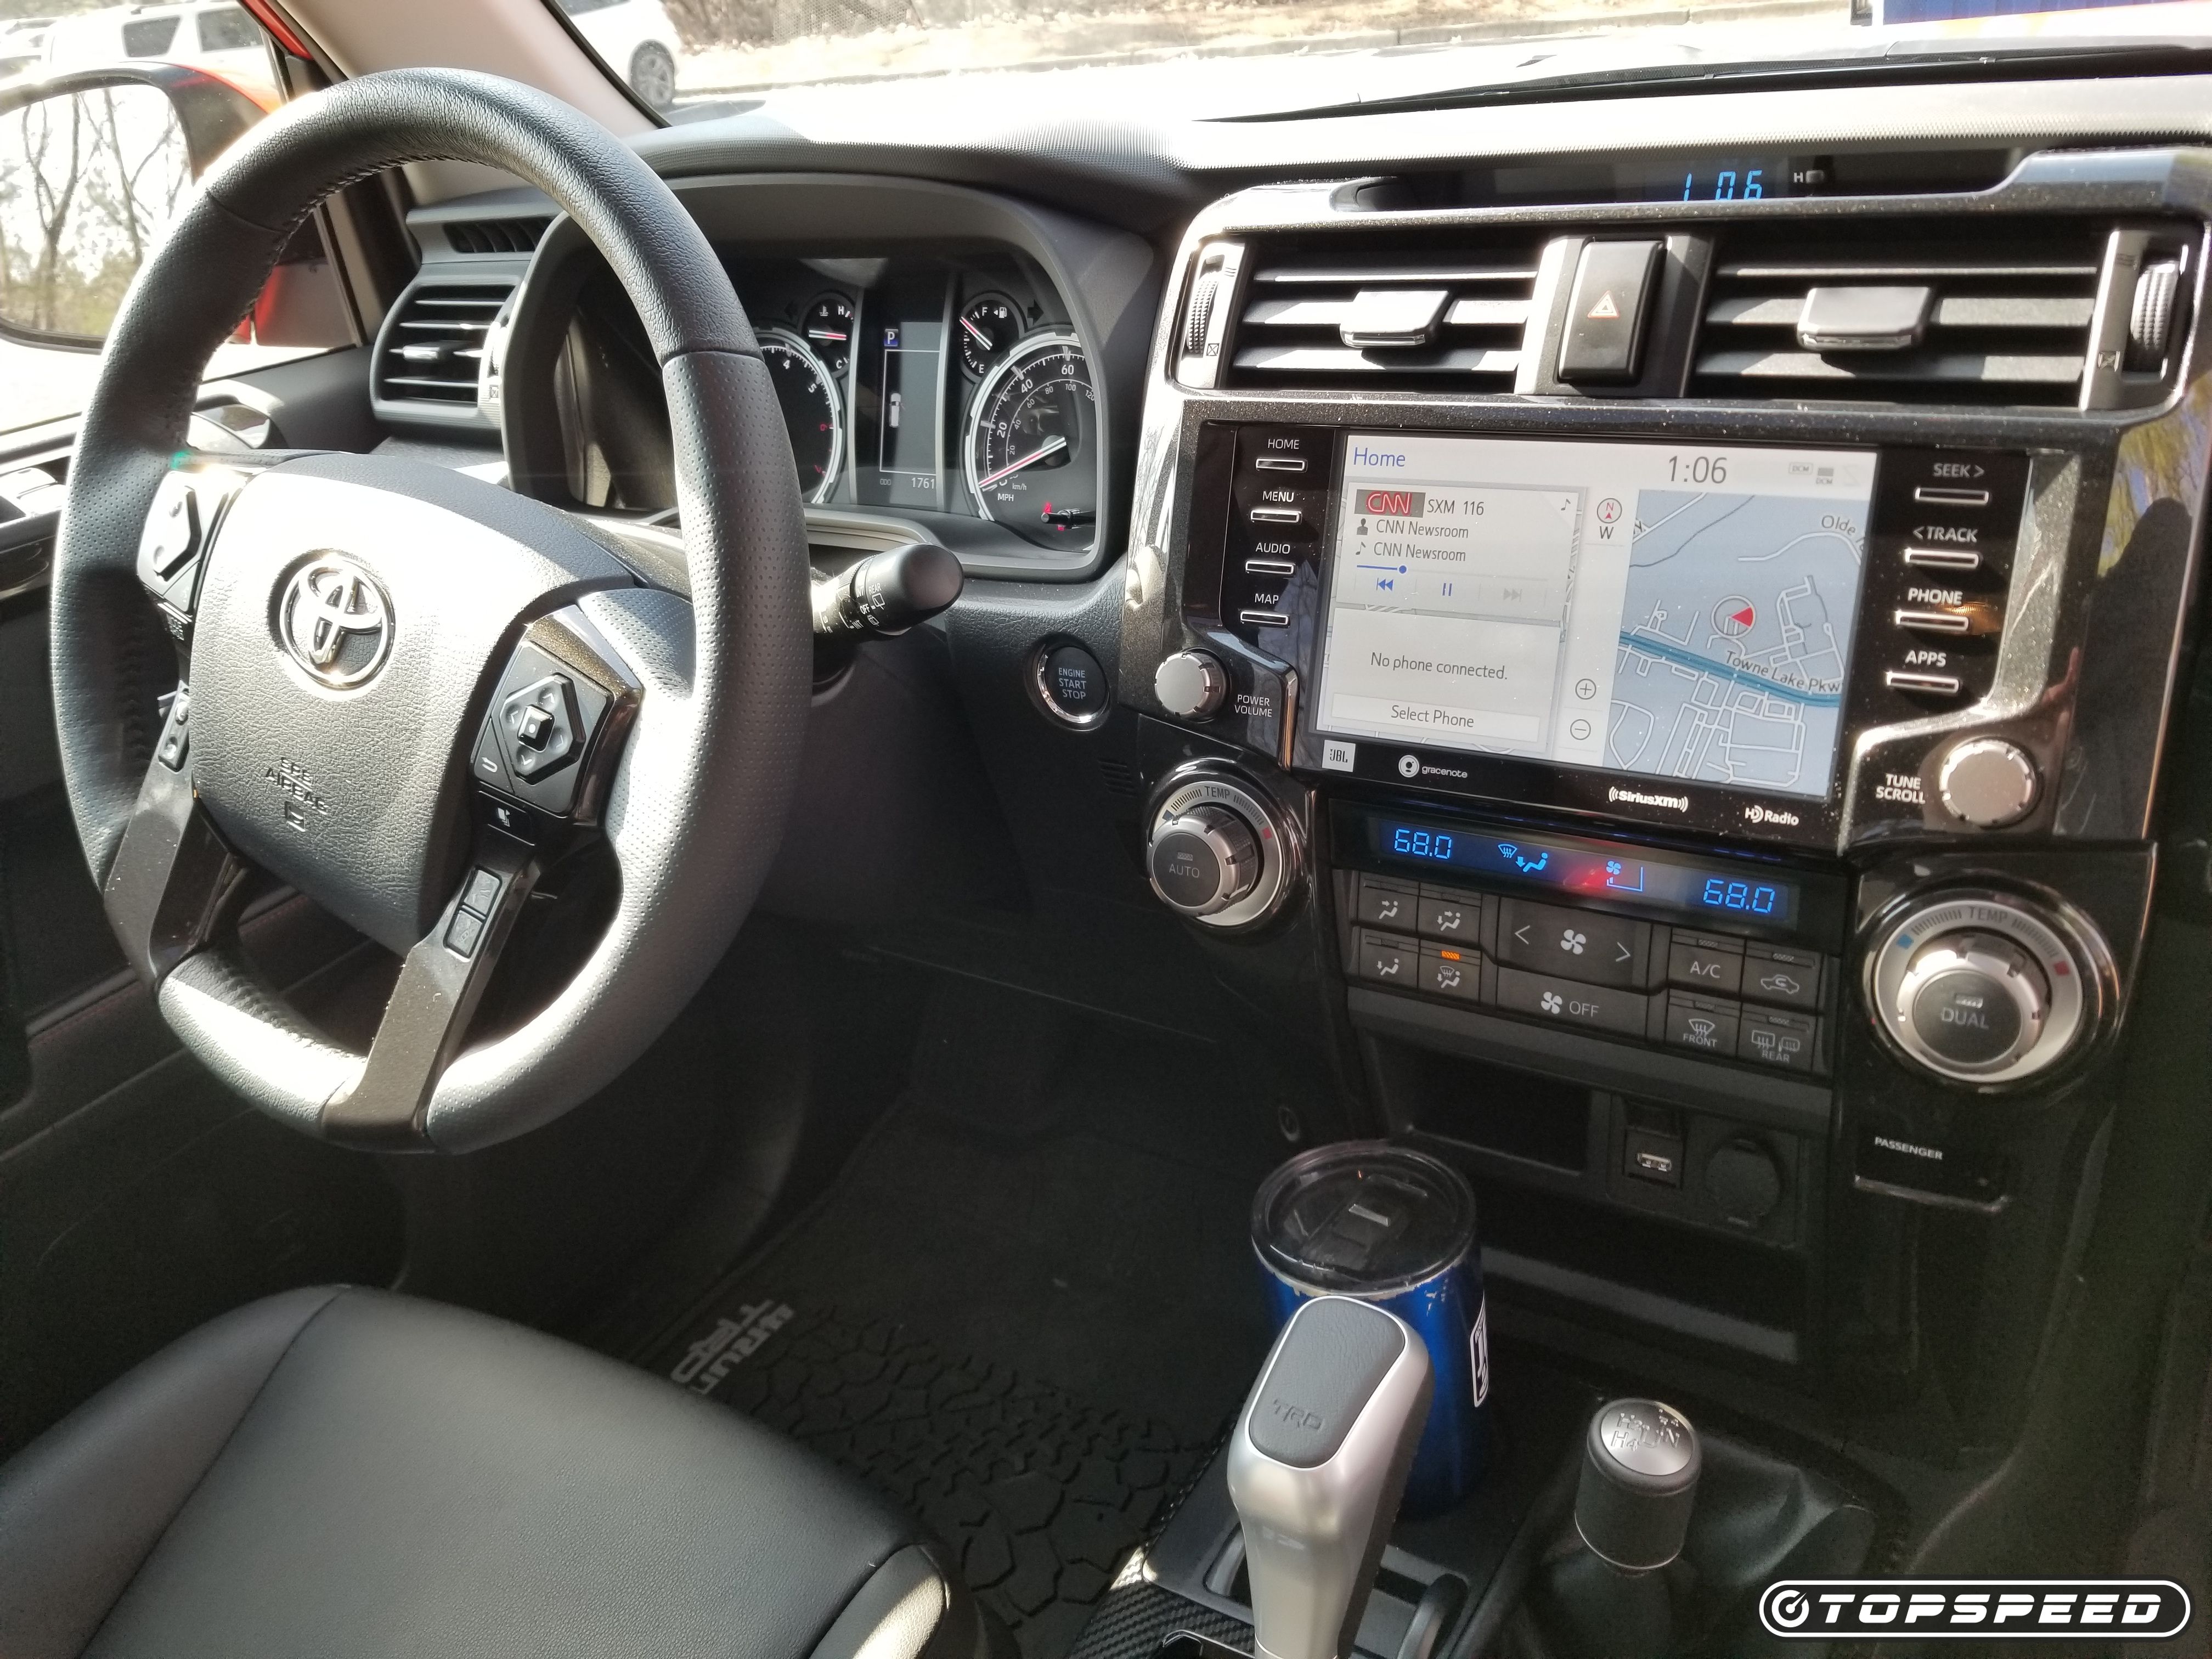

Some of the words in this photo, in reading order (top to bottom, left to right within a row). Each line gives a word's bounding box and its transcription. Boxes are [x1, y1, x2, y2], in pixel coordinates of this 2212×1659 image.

[982, 307, 988, 316] F
[887, 332, 895, 345] P
[783, 360, 791, 369] 4
[979, 364, 985, 374] E
[1062, 364, 1074, 375] 60
[808, 383, 817, 393] 5
[1020, 379, 1034, 394] 40
[1045, 386, 1053, 395] 80
[1065, 383, 1076, 392] 100
[1026, 399, 1035, 409] 60
[997, 422, 1007, 438] 20
[1014, 419, 1022, 430] 40
[1009, 445, 1015, 455] 20
[1267, 439, 1300, 450] HOME
[1353, 447, 1406, 467] Home
[1669, 455, 1727, 484] 1:06
[1933, 464, 1971, 477] SEEK
[1012, 483, 1027, 491] km/h
[997, 493, 1014, 501] MPH
[1262, 491, 1294, 503] MENU
[1366, 492, 1412, 516] CNN
[1427, 499, 1455, 515] SXM
[1463, 501, 1484, 516] 116
[1376, 519, 1404, 535] CNN
[1408, 521, 1469, 539] Newsroom
[1821, 515, 1857, 535] Olde
[1600, 526, 1614, 539] W
[1926, 527, 1978, 543] TRACK
[1255, 542, 1290, 554] AUDIO
[1373, 542, 1402, 558] CNN
[1405, 544, 1466, 562] Newsroom
[856, 586, 865, 598] INT
[868, 583, 882, 595] REAR
[1255, 593, 1279, 605] MAP
[1908, 589, 1963, 605] PHONE
[860, 603, 870, 615] OFF
[1370, 652, 1390, 669] No
[1392, 655, 1433, 674] phone
[1436, 661, 1508, 680] connected.
[1905, 651, 1946, 667] APPS
[1058, 668, 1085, 679] ENGINE
[1726, 651, 1769, 676] Towne
[1771, 667, 1804, 688] Lake
[1808, 678, 1842, 692] Pkw
[1059, 678, 1086, 690] START
[1063, 689, 1086, 699] STOP
[1237, 694, 1270, 707] POWER
[1234, 704, 1272, 718] VOLUME
[1391, 704, 1429, 723] Select
[1432, 710, 1474, 728] Phone
[1421, 766, 1468, 778] gracenote
[1886, 774, 1921, 788] TUNE
[1204, 786, 1230, 799] TEMP
[1876, 787, 1926, 804] SCROLL
[1745, 805, 1764, 823] HD
[1765, 809, 1799, 826] Radio
[1394, 828, 1452, 860] 68.0
[1169, 864, 1200, 878] AUTO
[1703, 878, 1775, 913] 68.0
[1968, 907, 2008, 923] TEMP
[1690, 961, 1721, 979] A/C
[1569, 1000, 1599, 1018] OFF
[1941, 1007, 1989, 1030] DUAL
[1683, 1033, 1717, 1048] FRONT
[1762, 1049, 1790, 1063] REAR
[1874, 1136, 1943, 1160] PASSENGER
